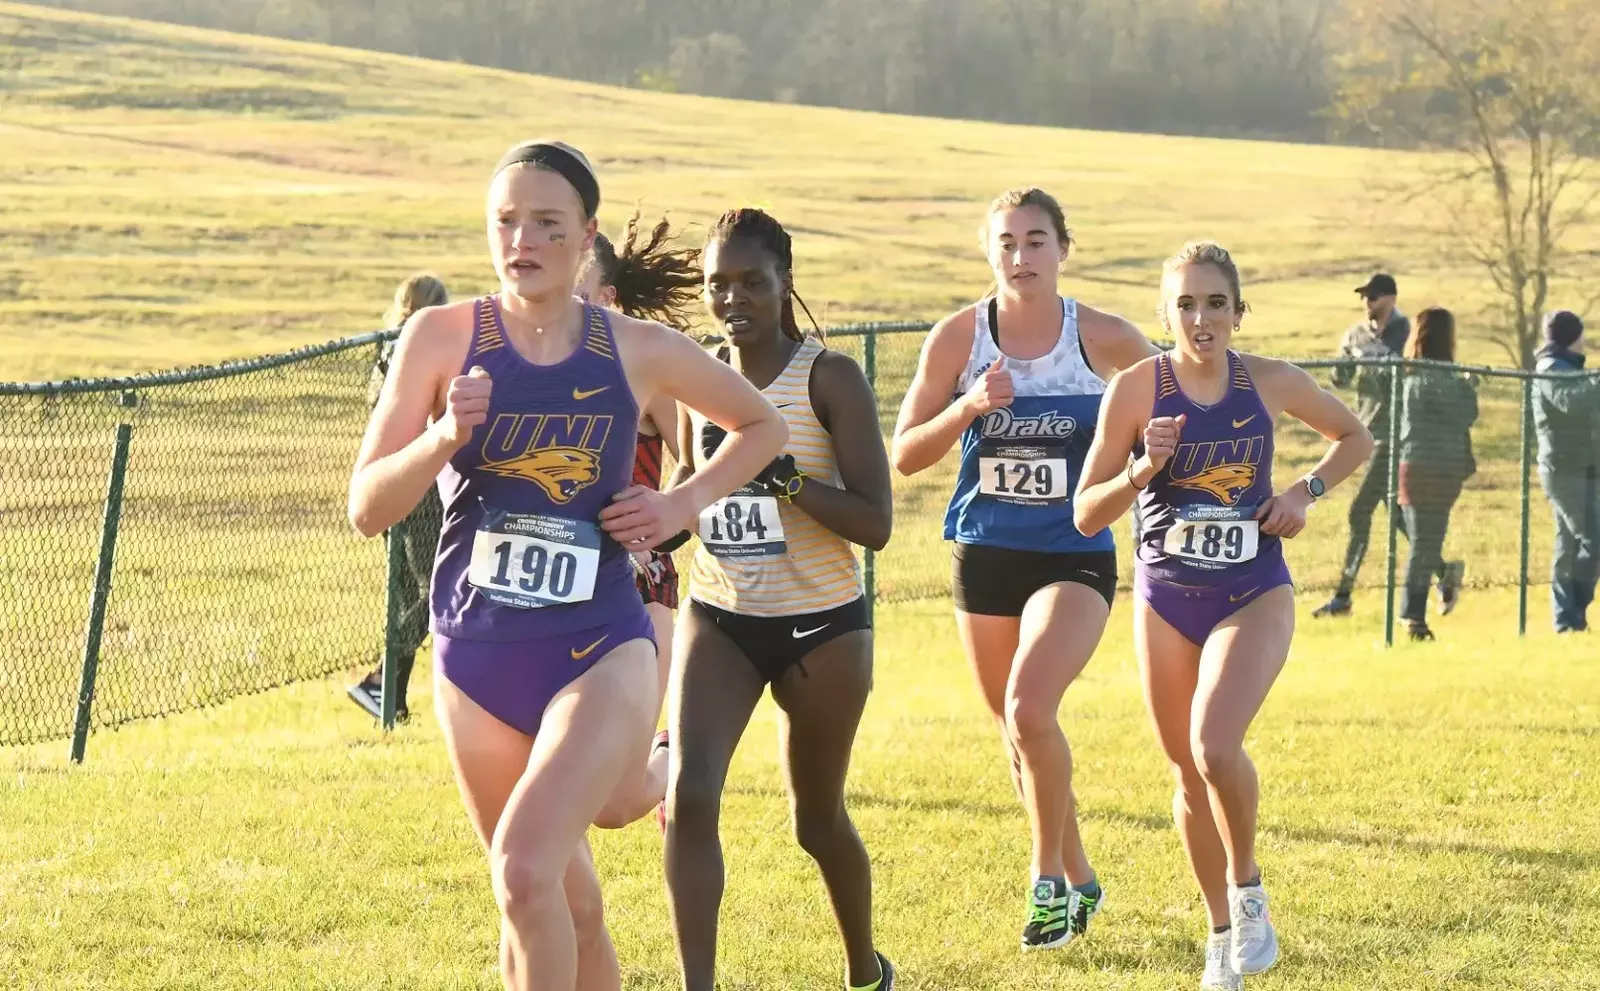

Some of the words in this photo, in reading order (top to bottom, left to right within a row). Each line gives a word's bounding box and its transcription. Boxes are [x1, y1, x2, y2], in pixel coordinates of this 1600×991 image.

[481, 413, 614, 464] UNI
[980, 405, 1077, 440] Drake
[1169, 435, 1265, 481] UNI
[993, 462, 1053, 496] 129
[504, 522, 576, 540] CHAMPIONSHIPS
[536, 520, 565, 530] COUNTRY
[710, 502, 768, 542] 184
[1179, 524, 1244, 560] 189
[489, 541, 578, 598] 190
[490, 594, 513, 604] Indiana
[513, 598, 530, 608] State
